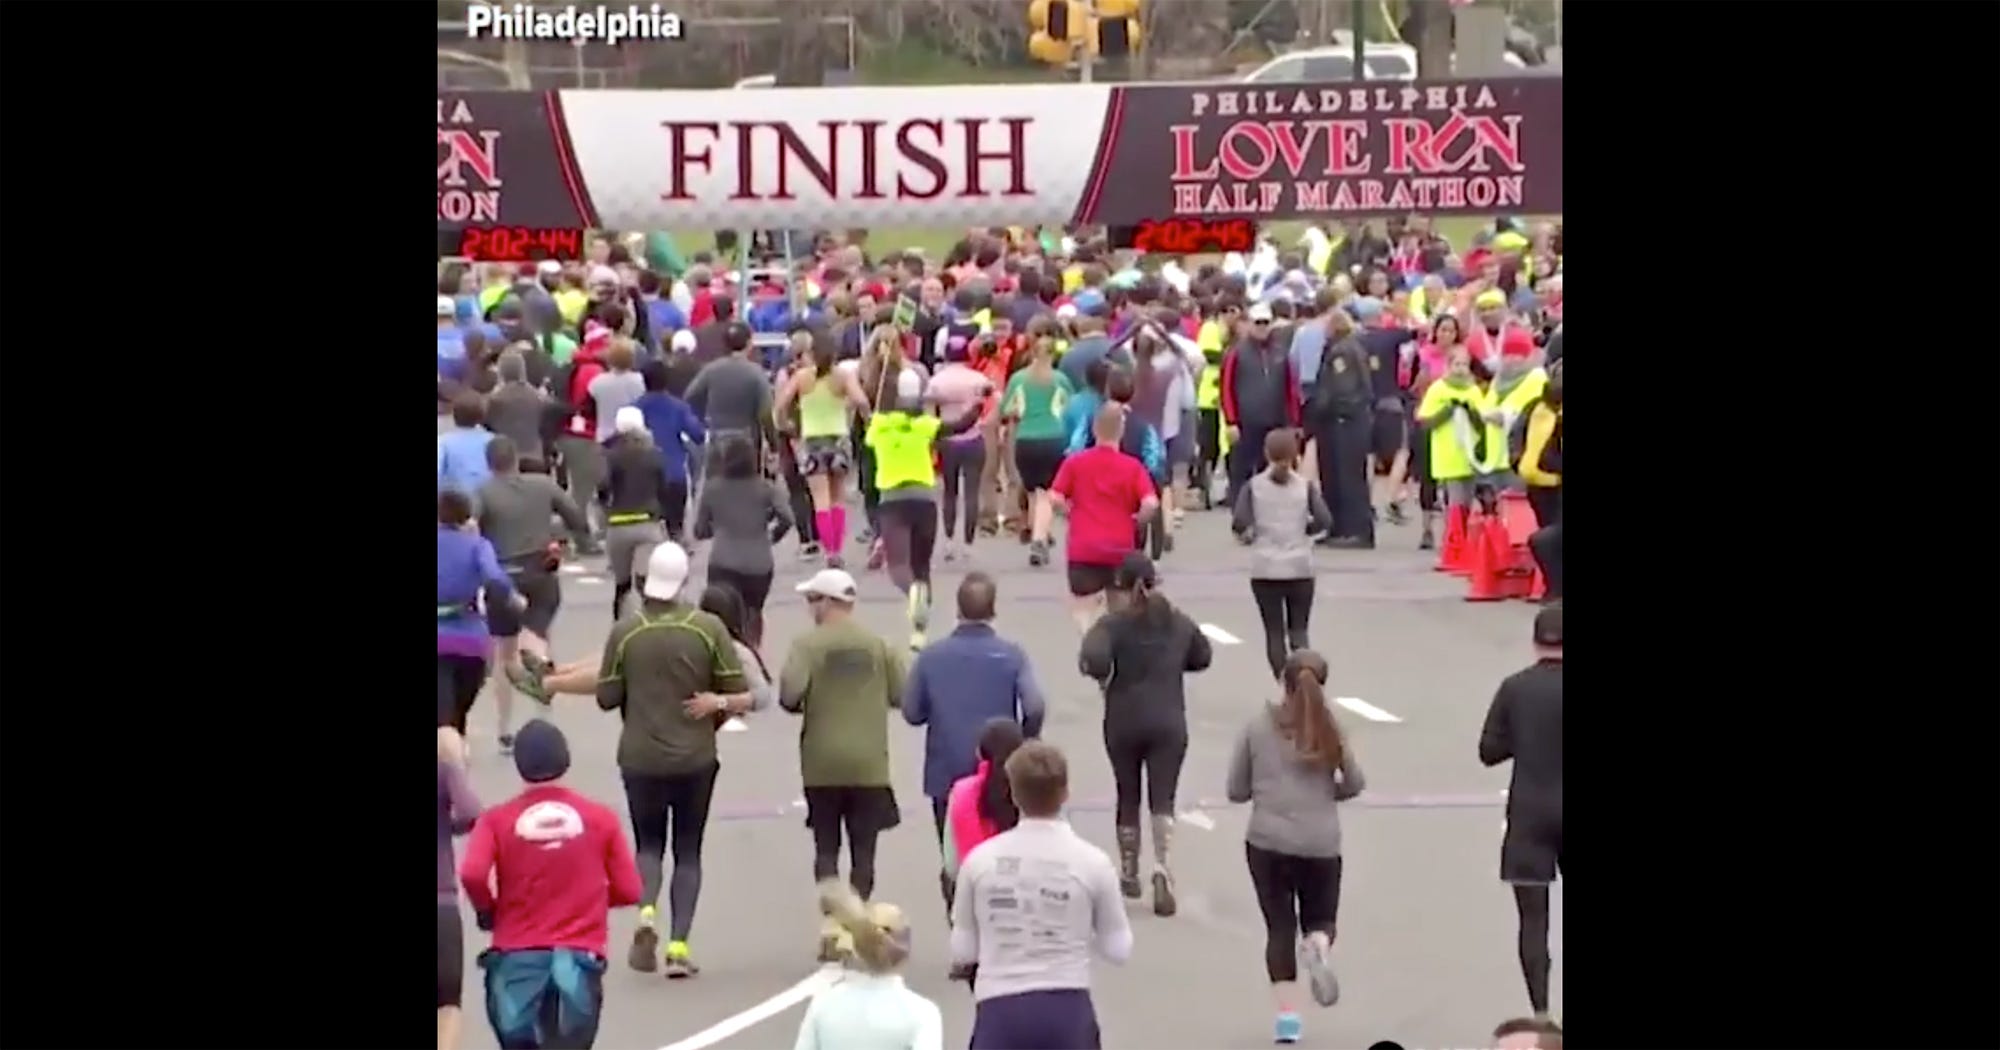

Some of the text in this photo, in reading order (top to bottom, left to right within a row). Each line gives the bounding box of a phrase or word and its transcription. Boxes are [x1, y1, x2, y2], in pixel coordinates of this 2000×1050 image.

[1192, 85, 1497, 116] PHILADELPHIA
[660, 117, 1035, 202] FINISH
[1170, 107, 1525, 180] LOVE RUN
[437, 189, 500, 221] ON
[1173, 175, 1523, 214] HALF MARATHON
